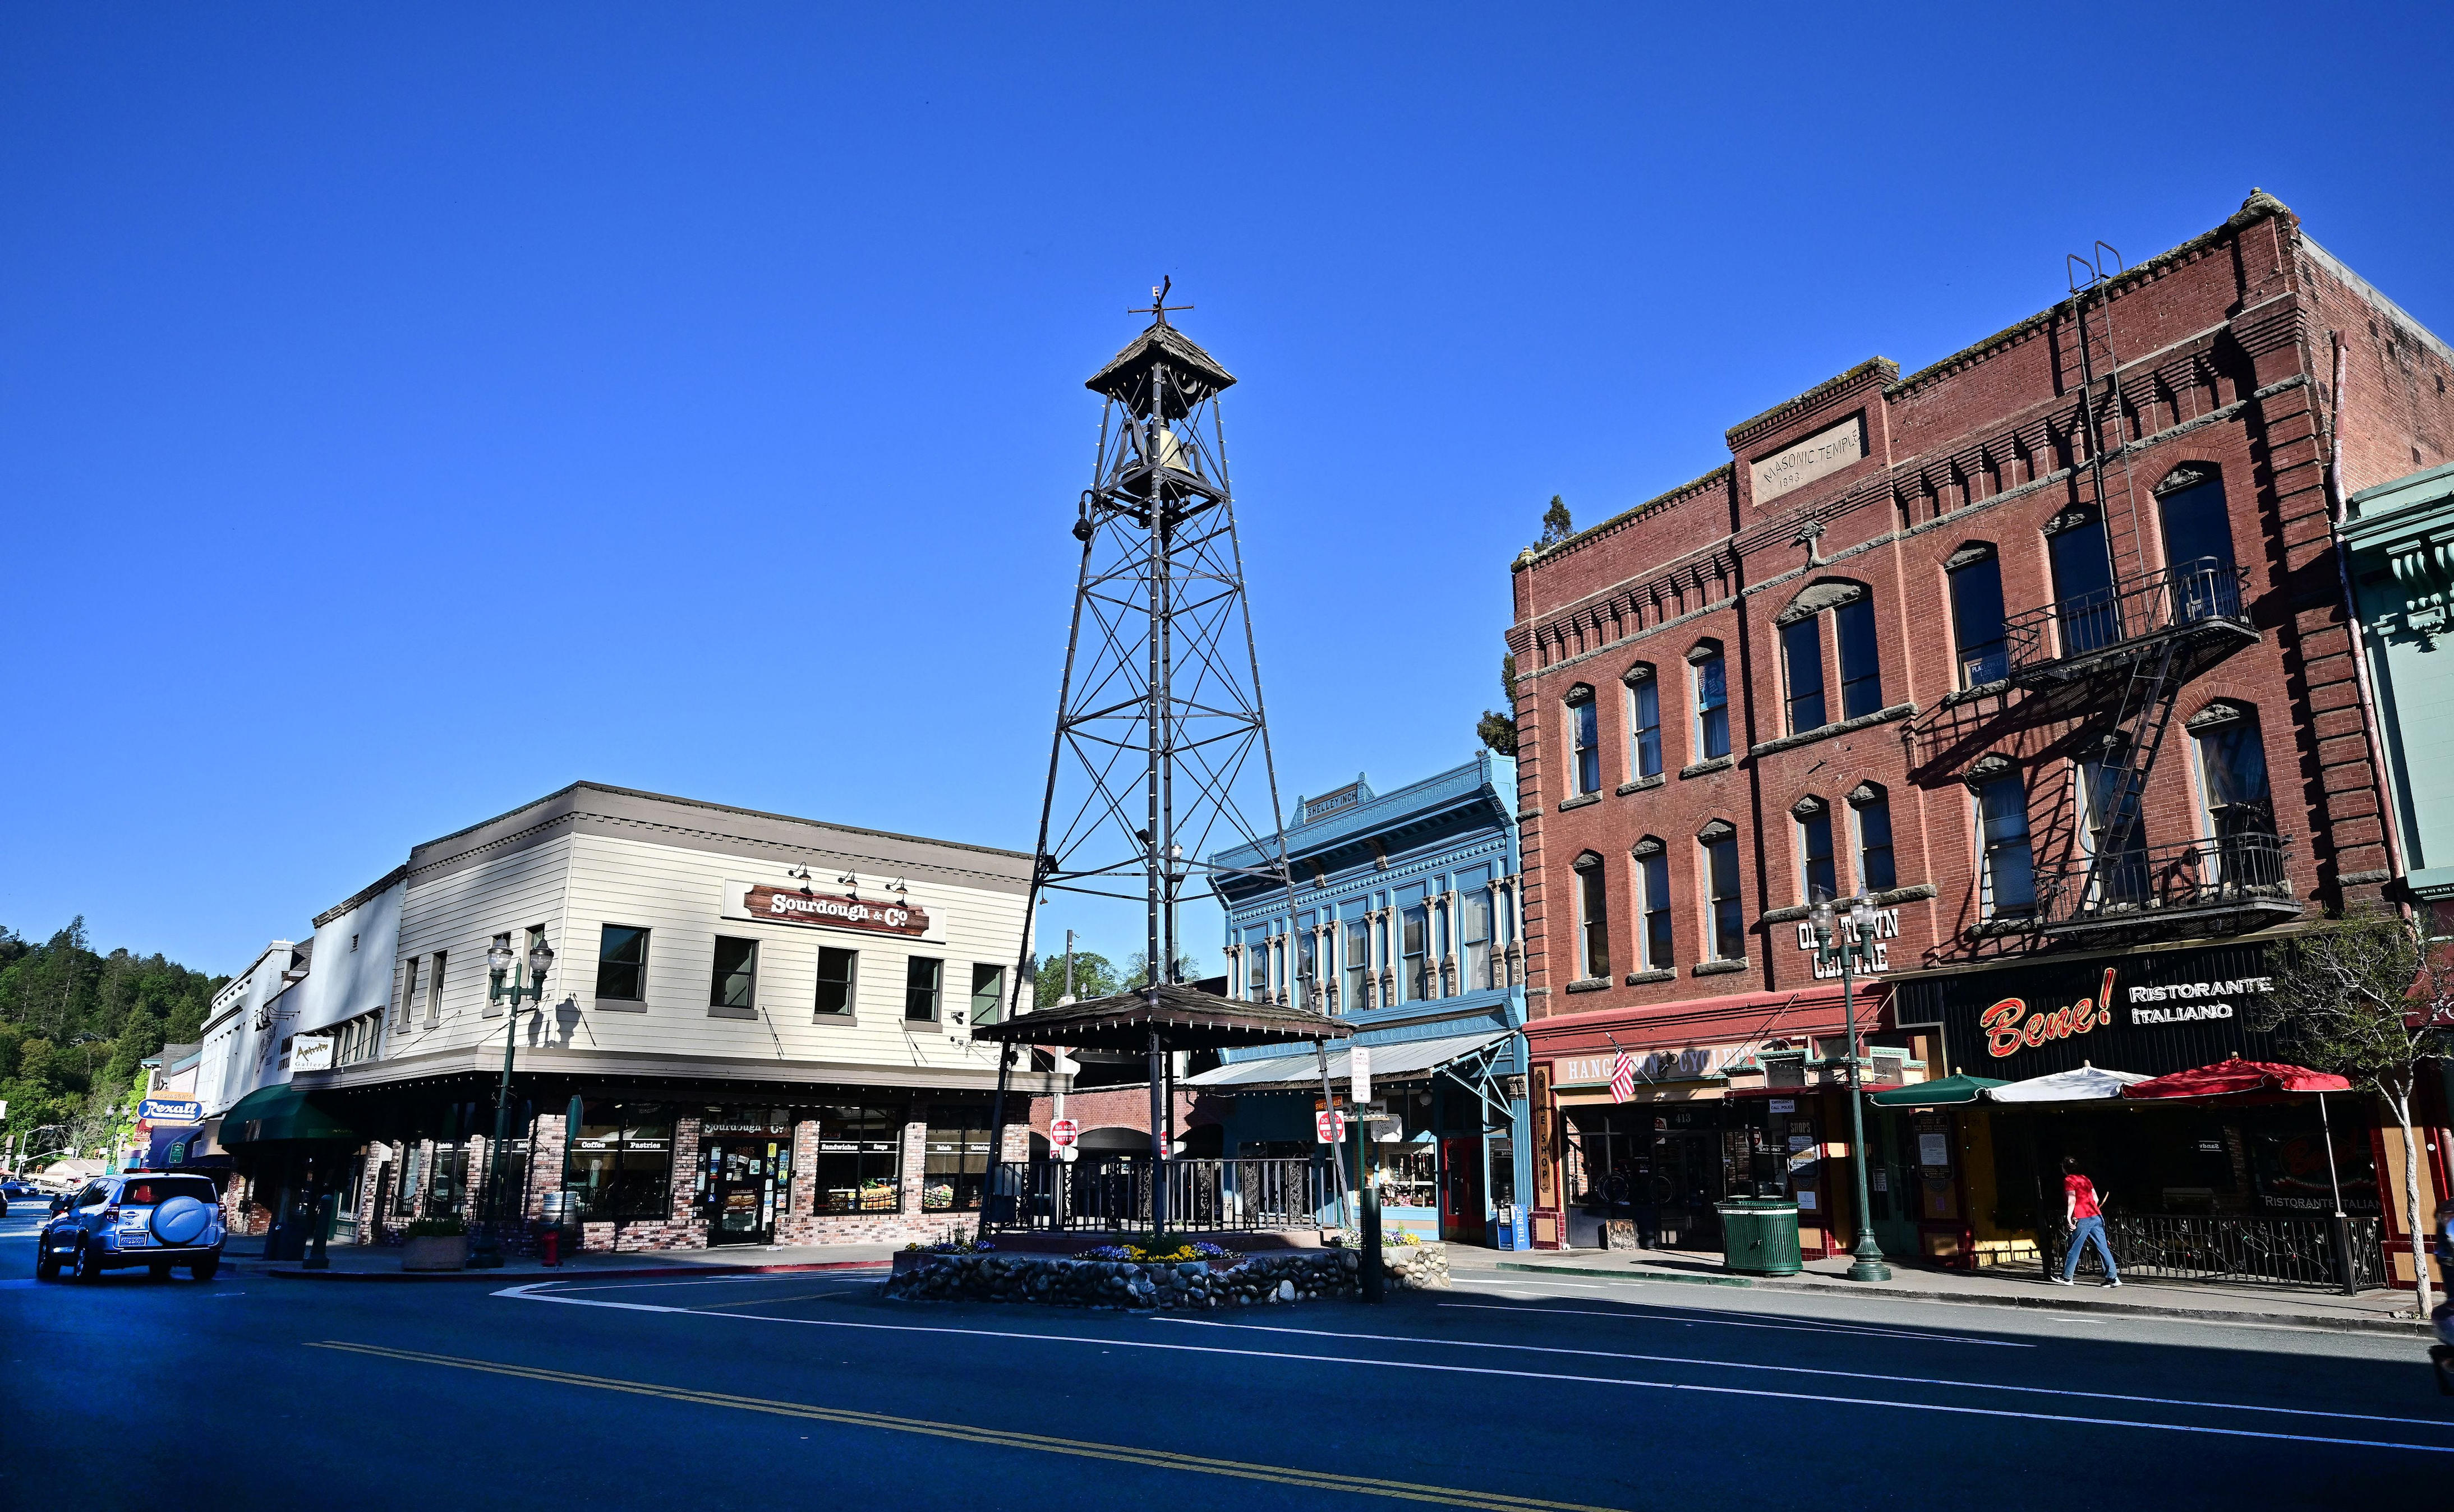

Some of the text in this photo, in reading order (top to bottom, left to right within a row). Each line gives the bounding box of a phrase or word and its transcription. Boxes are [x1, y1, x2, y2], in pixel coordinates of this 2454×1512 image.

[1763, 429, 1861, 483] MASONIC TEMPLE
[1308, 791, 1356, 817] SHELLEY INCH
[771, 893, 869, 921] Sourdough
[873, 910, 883, 921] &
[1798, 921, 1833, 949] OL
[1981, 967, 2117, 1057] Bene!
[1568, 1053, 1659, 1080] HANGWN
[143, 1100, 197, 1118] Rexall
[1675, 1113, 1691, 1123] 413
[1790, 1122, 1811, 1133] SHOPS
[735, 1146, 755, 1155] 385
[2265, 1195, 2333, 1208] RISTORANTE
